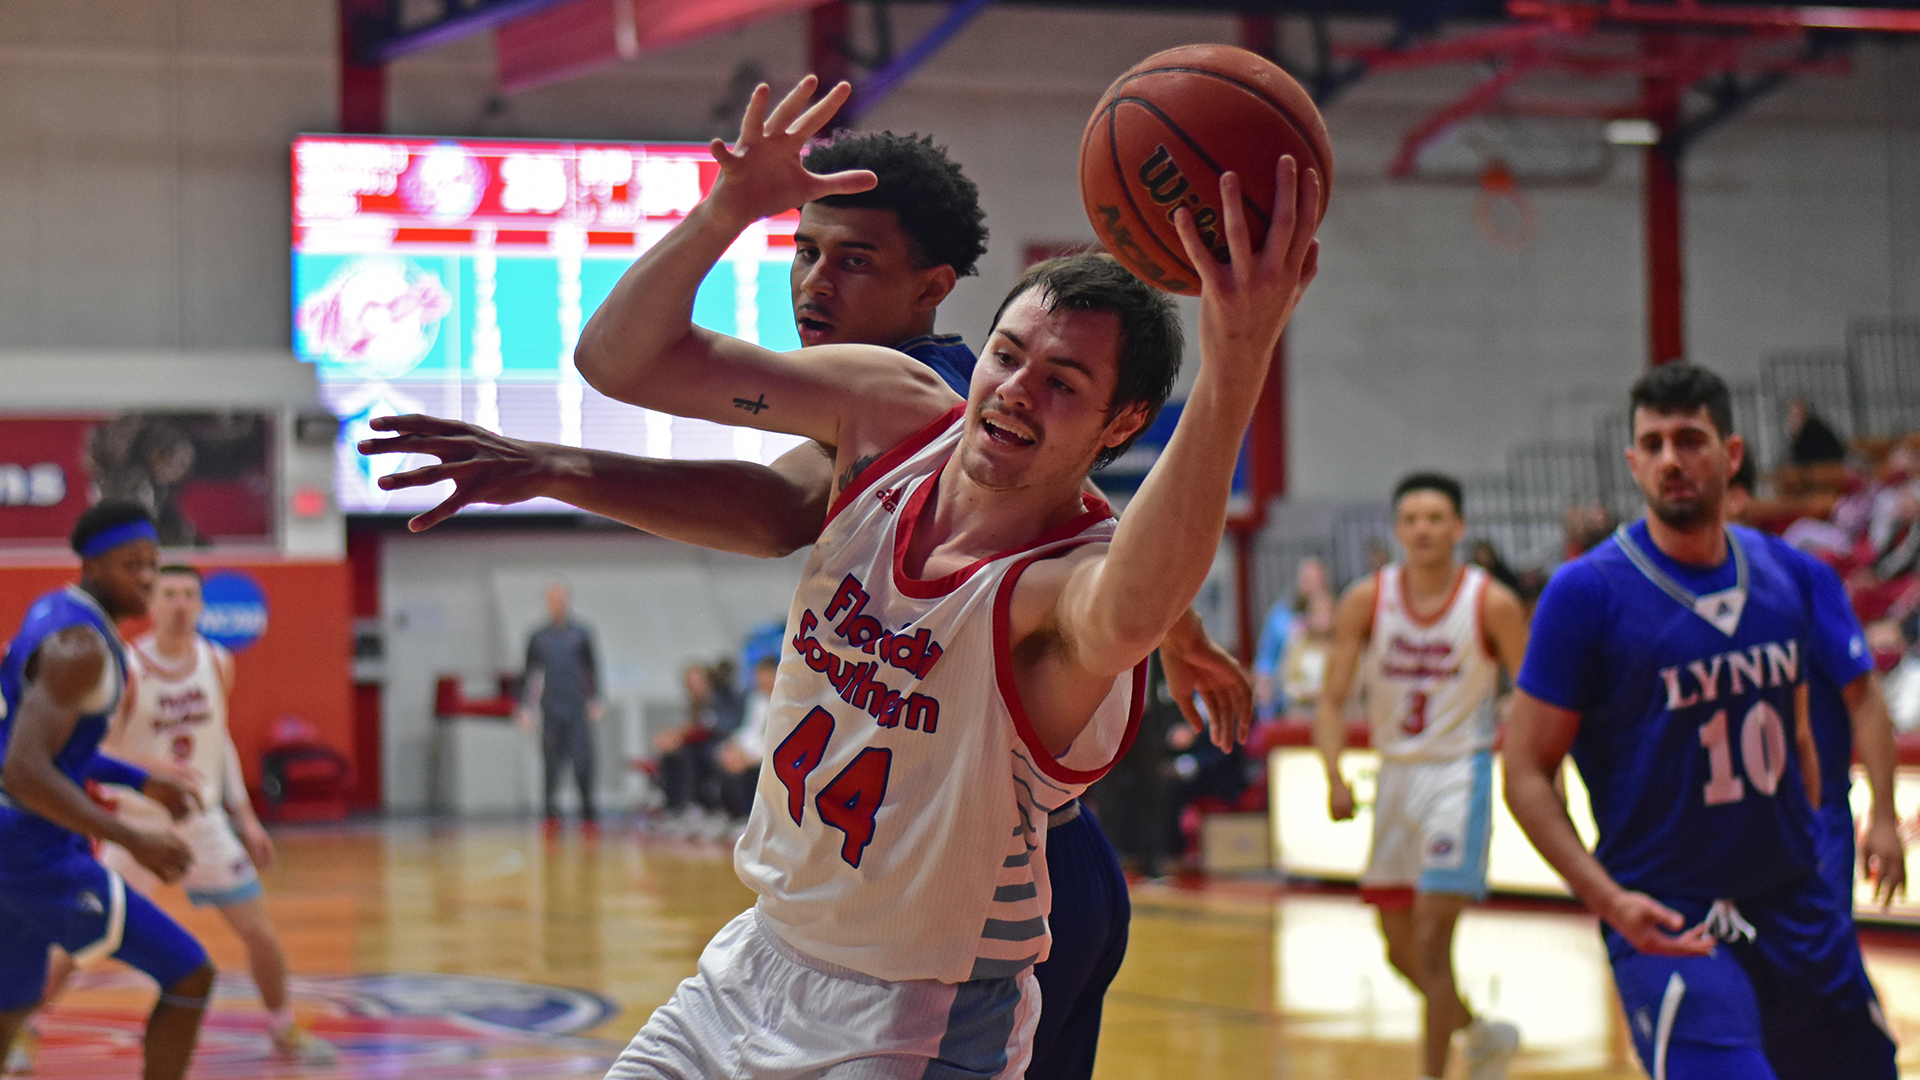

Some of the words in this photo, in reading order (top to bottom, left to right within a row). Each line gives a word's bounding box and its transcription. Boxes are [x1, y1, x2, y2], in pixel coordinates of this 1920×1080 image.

[792, 608, 940, 734] Southern
[823, 572, 944, 681] Florida
[1658, 637, 1799, 712] LYNN
[772, 704, 893, 870] 44
[1698, 699, 1788, 807] 10
